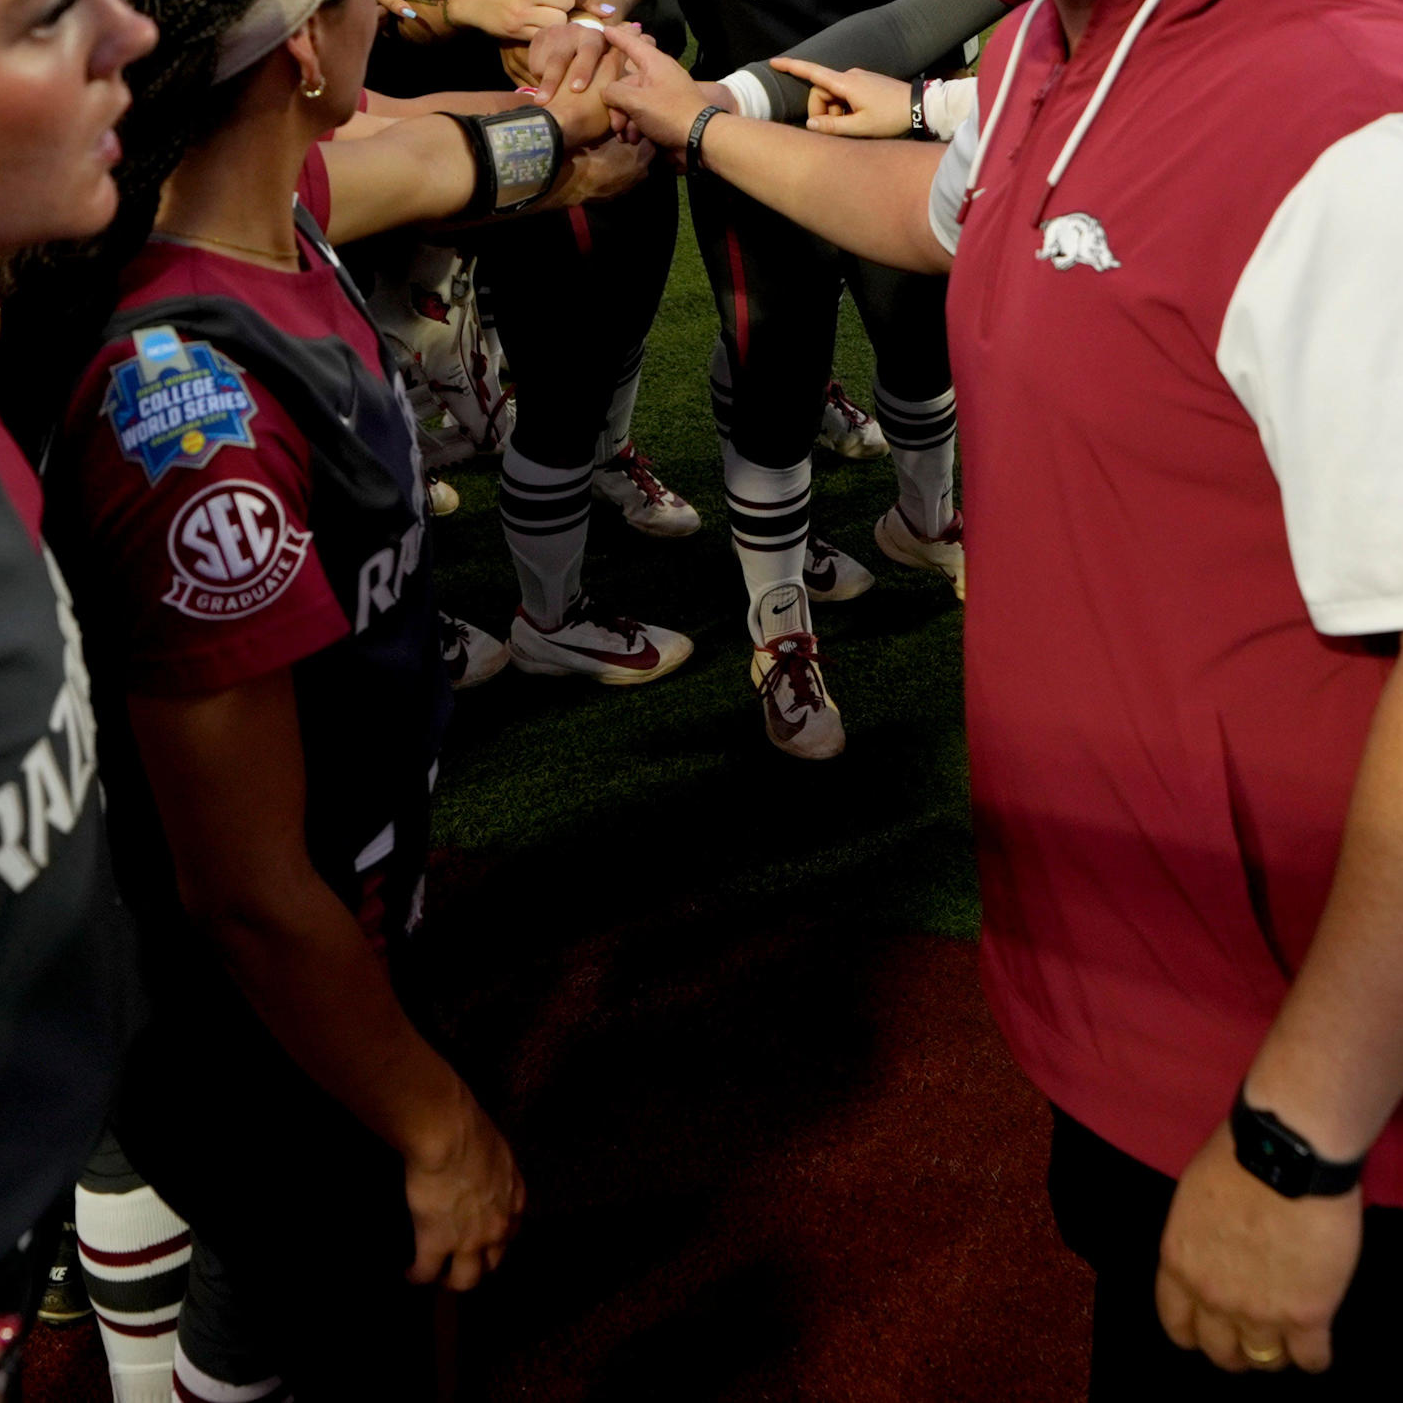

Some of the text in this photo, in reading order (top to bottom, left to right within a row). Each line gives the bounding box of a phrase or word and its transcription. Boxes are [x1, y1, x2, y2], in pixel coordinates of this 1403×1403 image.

[912, 103, 923, 129] FCA
[121, 391, 248, 451] WORLD SERIES
[138, 376, 218, 419] COLLEGE
[181, 491, 274, 581] SEC
[196, 557, 293, 612] GRADUATE
